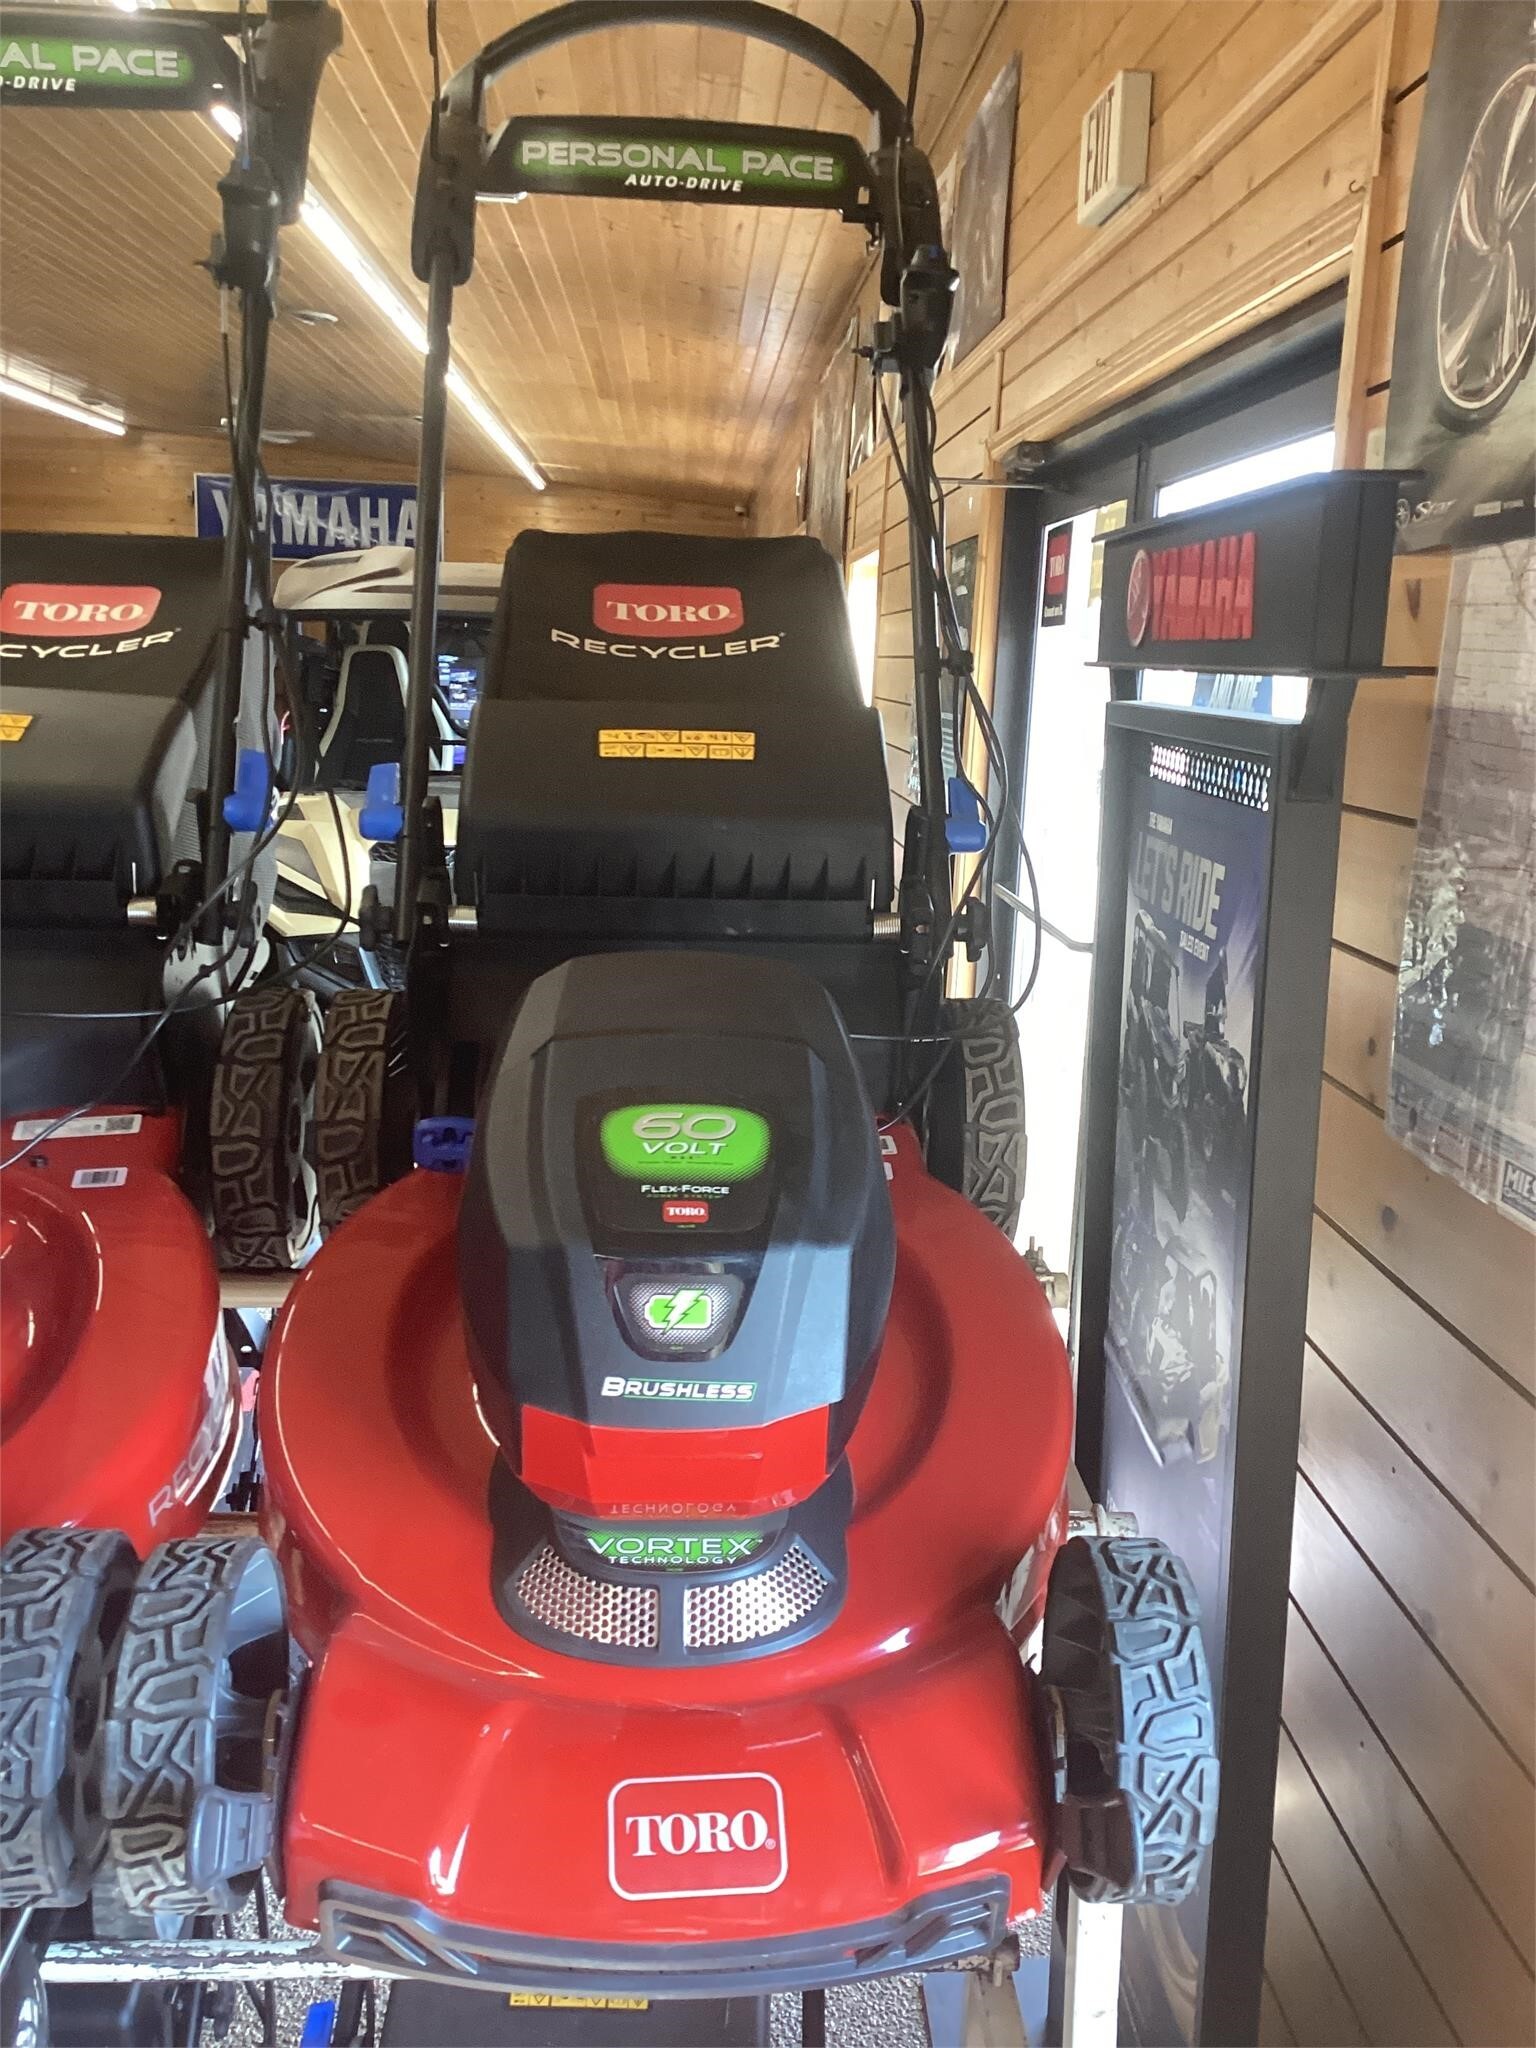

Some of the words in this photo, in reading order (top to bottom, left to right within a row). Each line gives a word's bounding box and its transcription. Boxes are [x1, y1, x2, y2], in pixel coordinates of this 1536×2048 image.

[72, 45, 179, 78] PACE
[1084, 85, 1115, 205] EXIT
[522, 140, 726, 173] PERSONAL
[742, 150, 834, 182] PACE
[624, 173, 743, 192] AUTO-DRIVE
[13, 600, 145, 622] TORO
[606, 601, 731, 622] TORO
[551, 628, 781, 659] RECYCLER
[1175, 850, 1226, 941] RIDE
[632, 1112, 736, 1140] 60
[642, 1142, 727, 1155] VOLT
[666, 1207, 706, 1217] TORO
[587, 1537, 753, 1556] VORTEX
[608, 1555, 737, 1565] TECHNOLOGY
[625, 1809, 769, 1857] TORO
